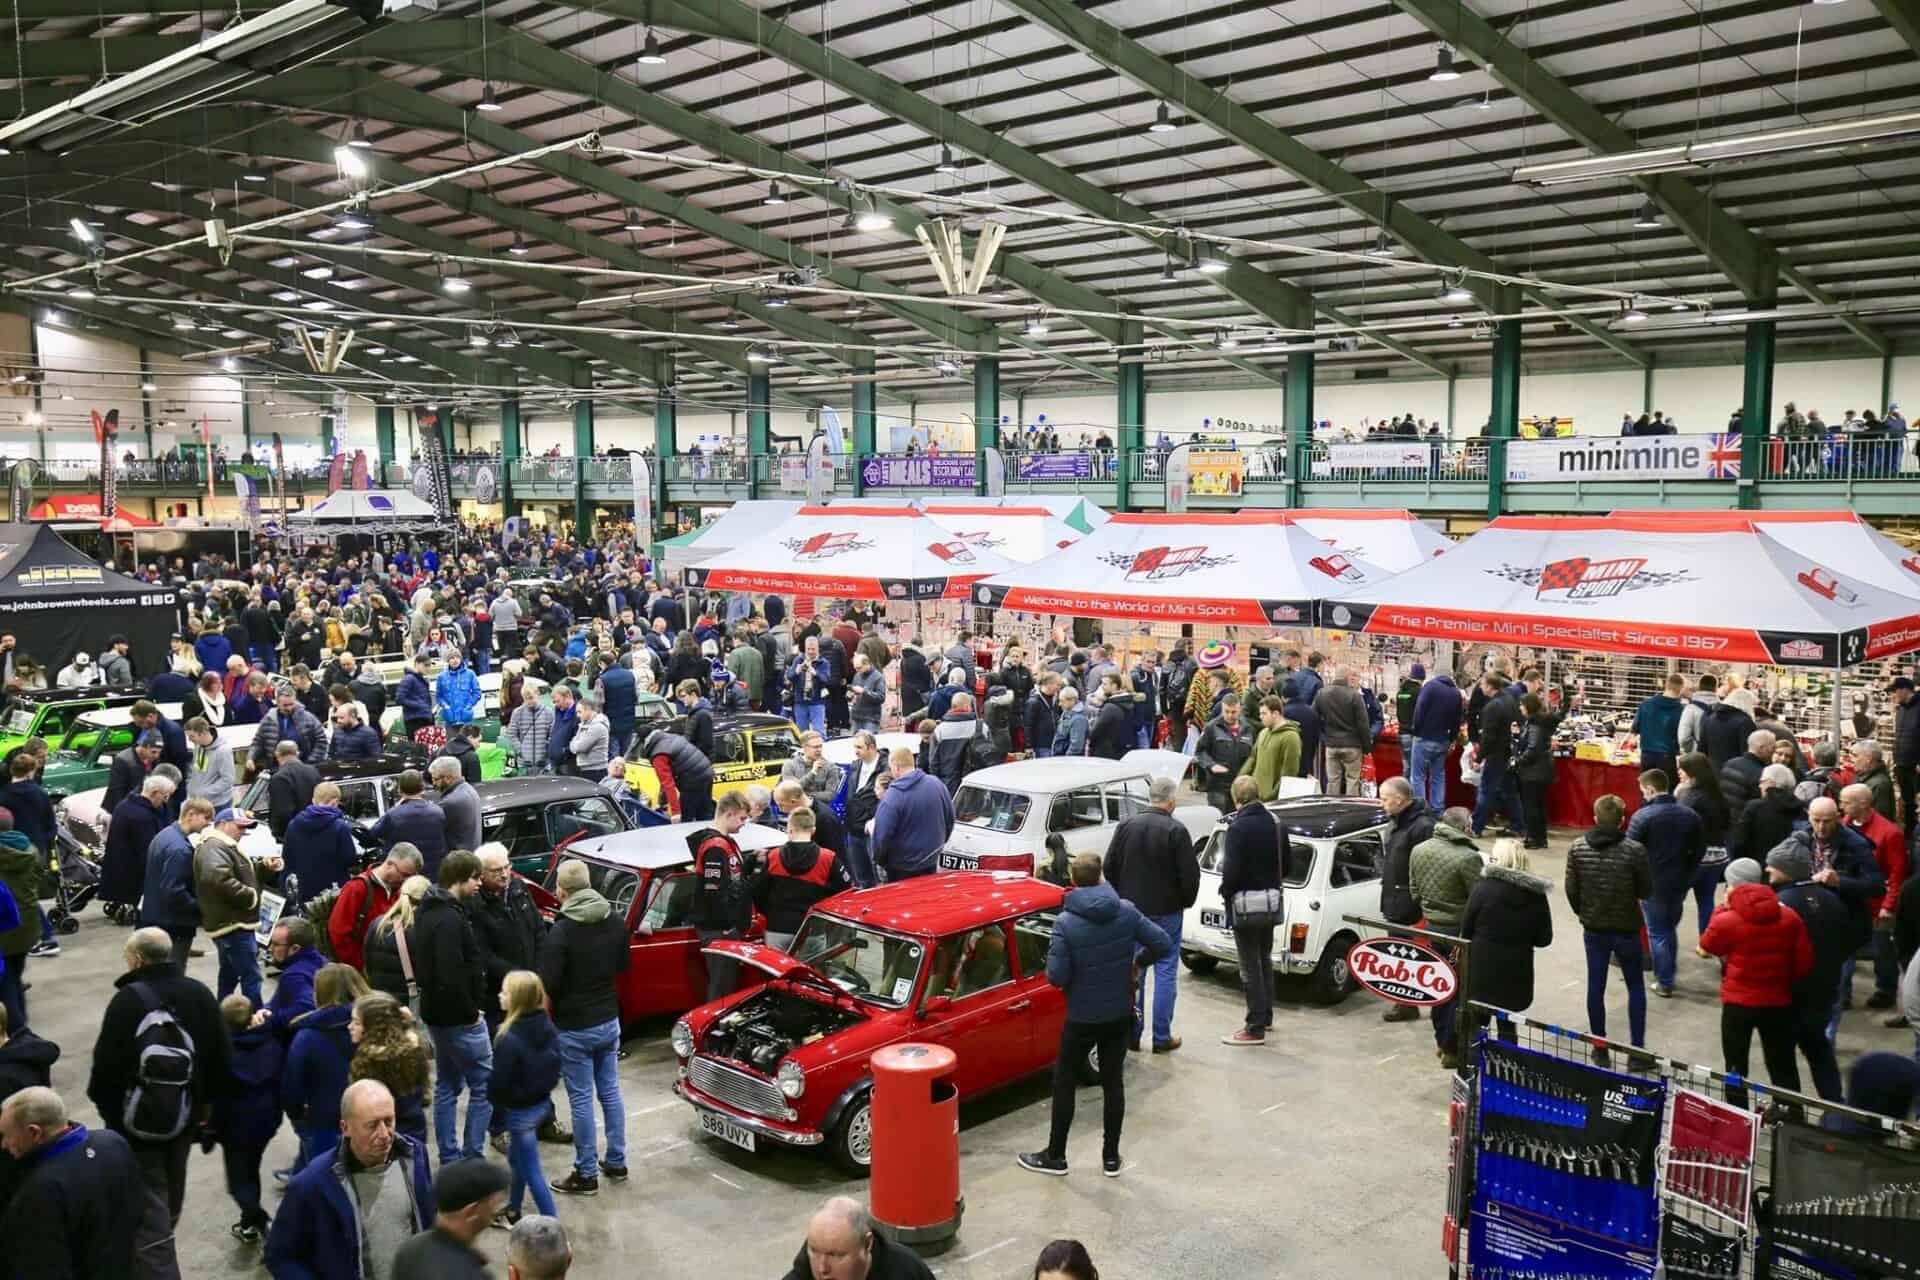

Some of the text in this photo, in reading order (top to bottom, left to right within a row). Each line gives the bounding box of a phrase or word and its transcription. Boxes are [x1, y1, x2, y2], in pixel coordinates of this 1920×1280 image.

[1559, 439, 1700, 472] minimine
[889, 459, 931, 485] MEALS
[1581, 559, 1640, 580] MINI
[795, 580, 812, 590] You
[814, 582, 831, 591] Can
[834, 583, 856, 592] Trust
[1571, 579, 1624, 597] SPORT
[0, 597, 136, 613] w.johnbrownwheels.com
[1024, 595, 1237, 618] Welcome to the World of Mini Sport
[1391, 614, 1729, 650] The Premier Mini Specialist Since 1967
[942, 855, 958, 869] 157
[1377, 982, 1425, 999] TOOLS
[702, 1114, 750, 1147] S89 UVX
